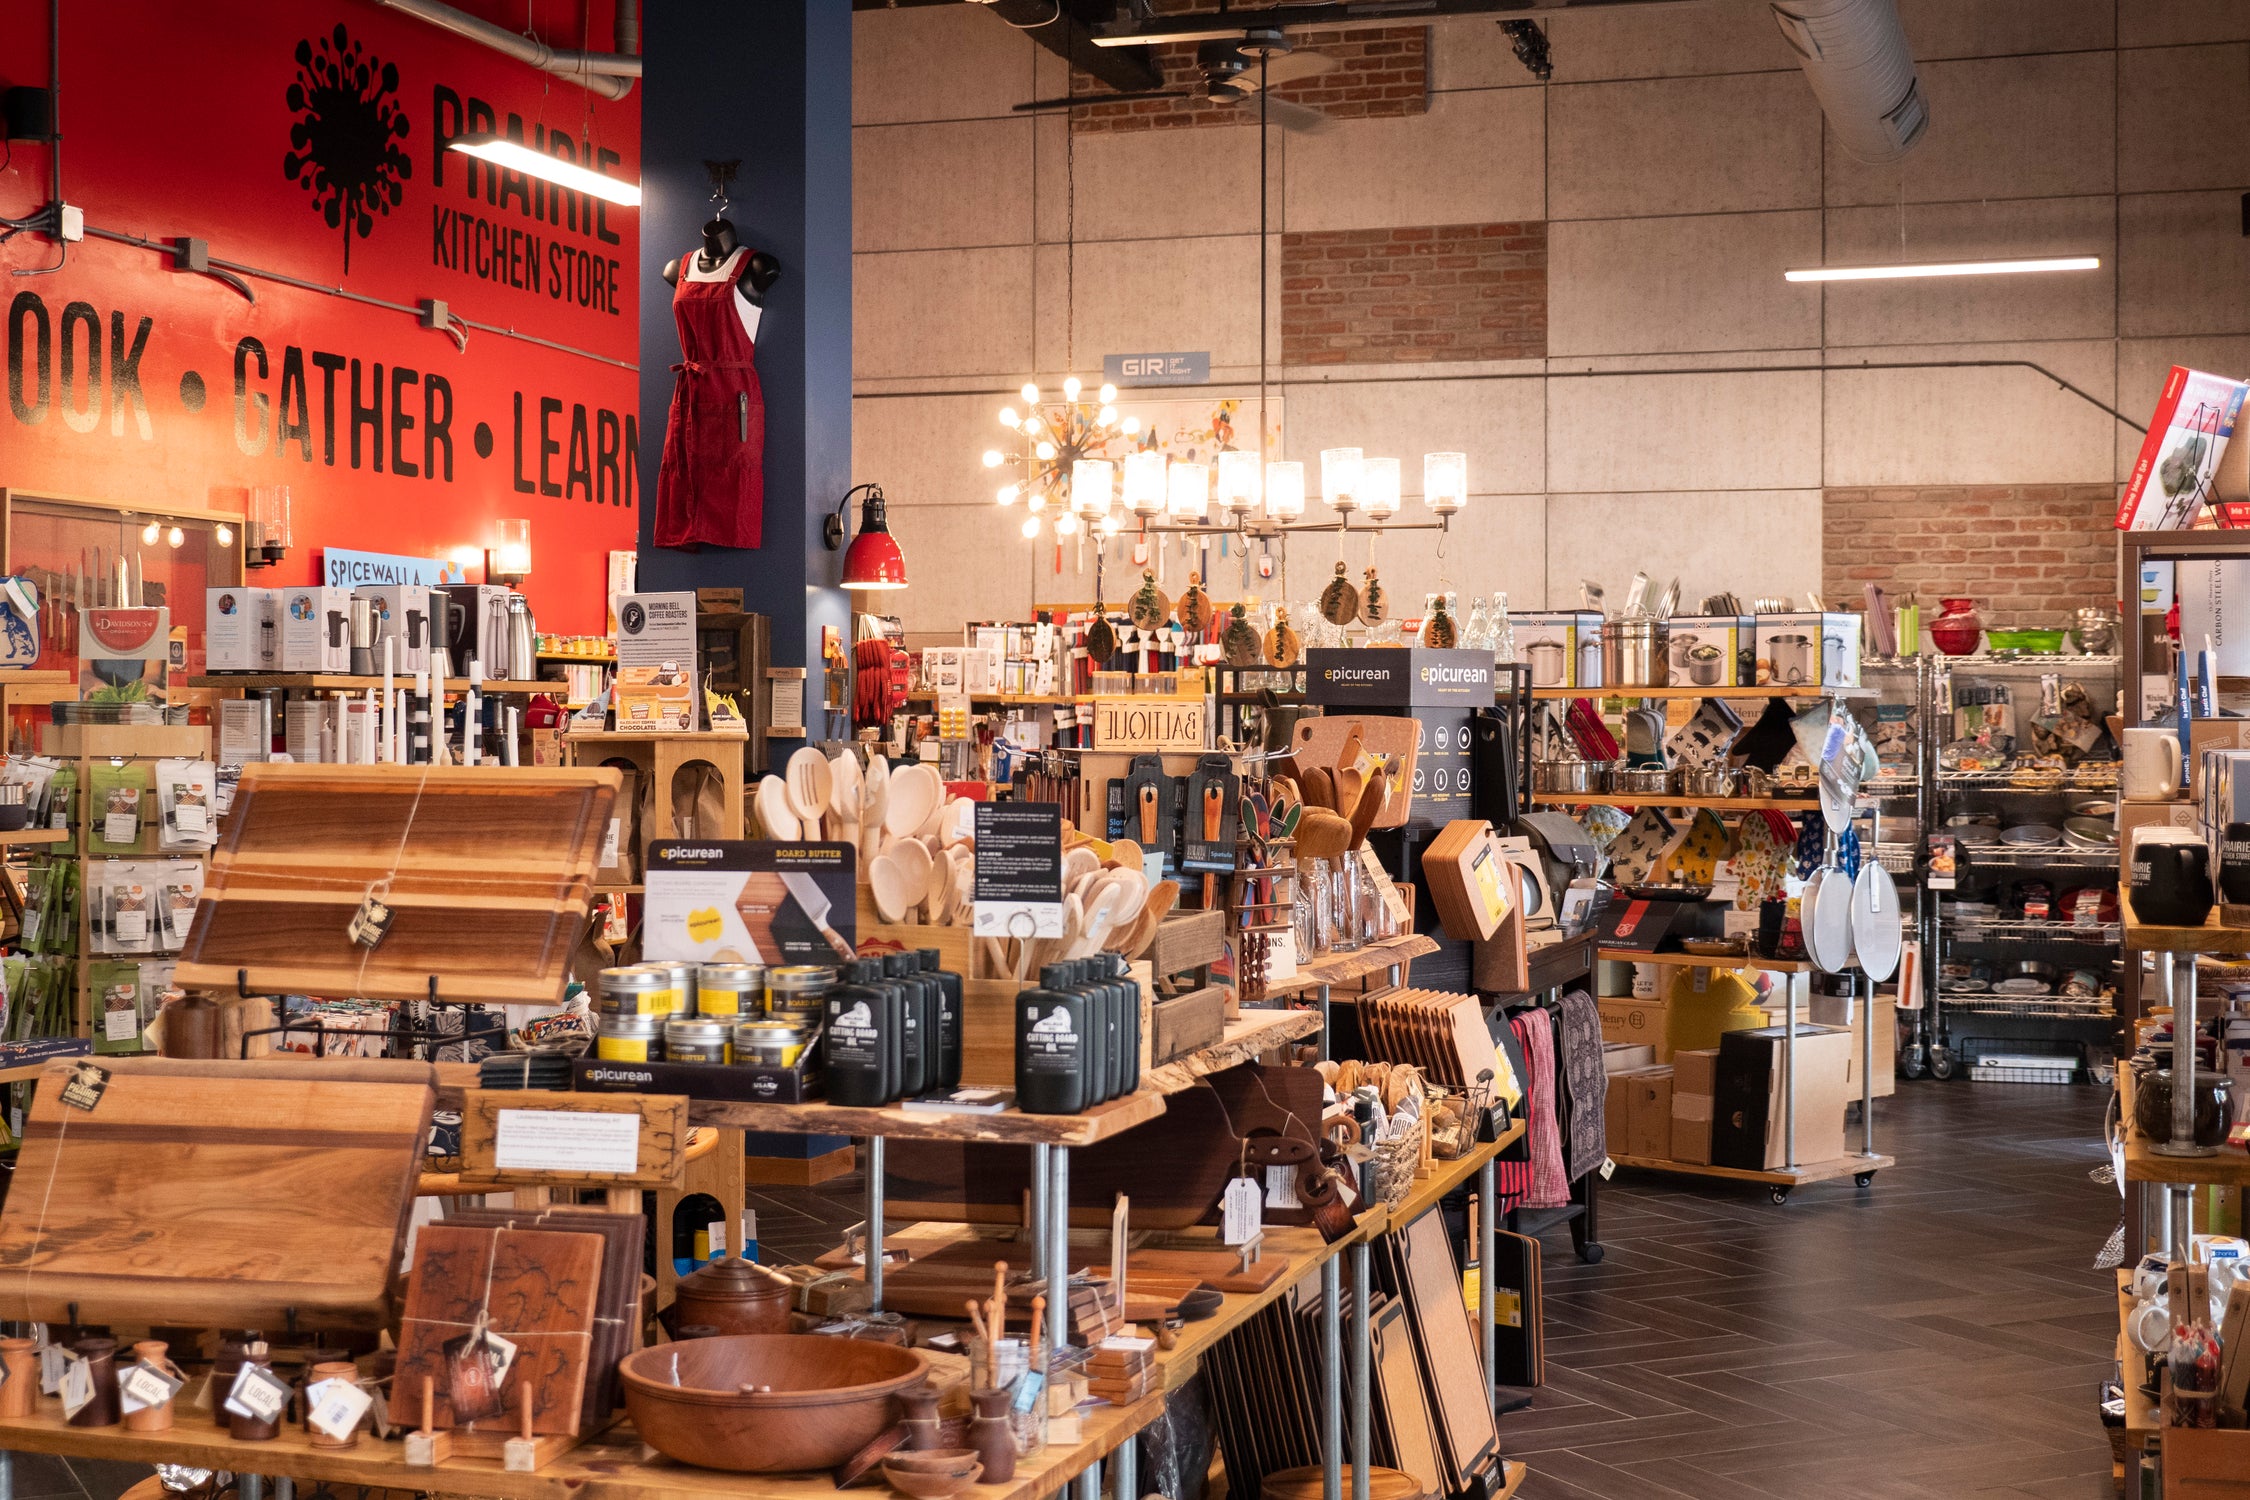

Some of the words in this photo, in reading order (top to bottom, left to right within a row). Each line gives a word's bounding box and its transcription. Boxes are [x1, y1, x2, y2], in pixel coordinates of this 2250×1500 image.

[433, 84, 620, 246] PRAIRIE
[433, 204, 540, 294] KITCHEN
[549, 241, 620, 316] STORE
[1122, 358, 1164, 376] GIR
[233, 336, 454, 483] GATHER
[331, 559, 421, 587] SPICEWALLA
[2215, 578, 2223, 605] STEEL
[649, 602, 668, 610] MORNING
[669, 602, 680, 610] BELL
[649, 611, 665, 619] COFFEE
[665, 610, 688, 619] ROASTERS
[2215, 607, 2223, 647] CARBON
[1324, 666, 1390, 682] epicurean
[1420, 663, 1488, 685] epicurean
[1733, 707, 1762, 718] Henr
[660, 846, 723, 860] epicurean
[775, 849, 807, 858] BOARD
[808, 849, 842, 859] BUTTER
[1210, 851, 1233, 859] Spatula
[829, 1026, 855, 1037] CUTTING
[855, 1028, 879, 1039] BOARD
[1026, 1032, 1055, 1043] CUTTING
[1055, 1033, 1079, 1044] BOARD
[585, 1067, 653, 1084] epicurean
[67, 1082, 101, 1101] PRAIRIE
[135, 1378, 163, 1398] LOCAL
[248, 1384, 275, 1408] LOCAL
